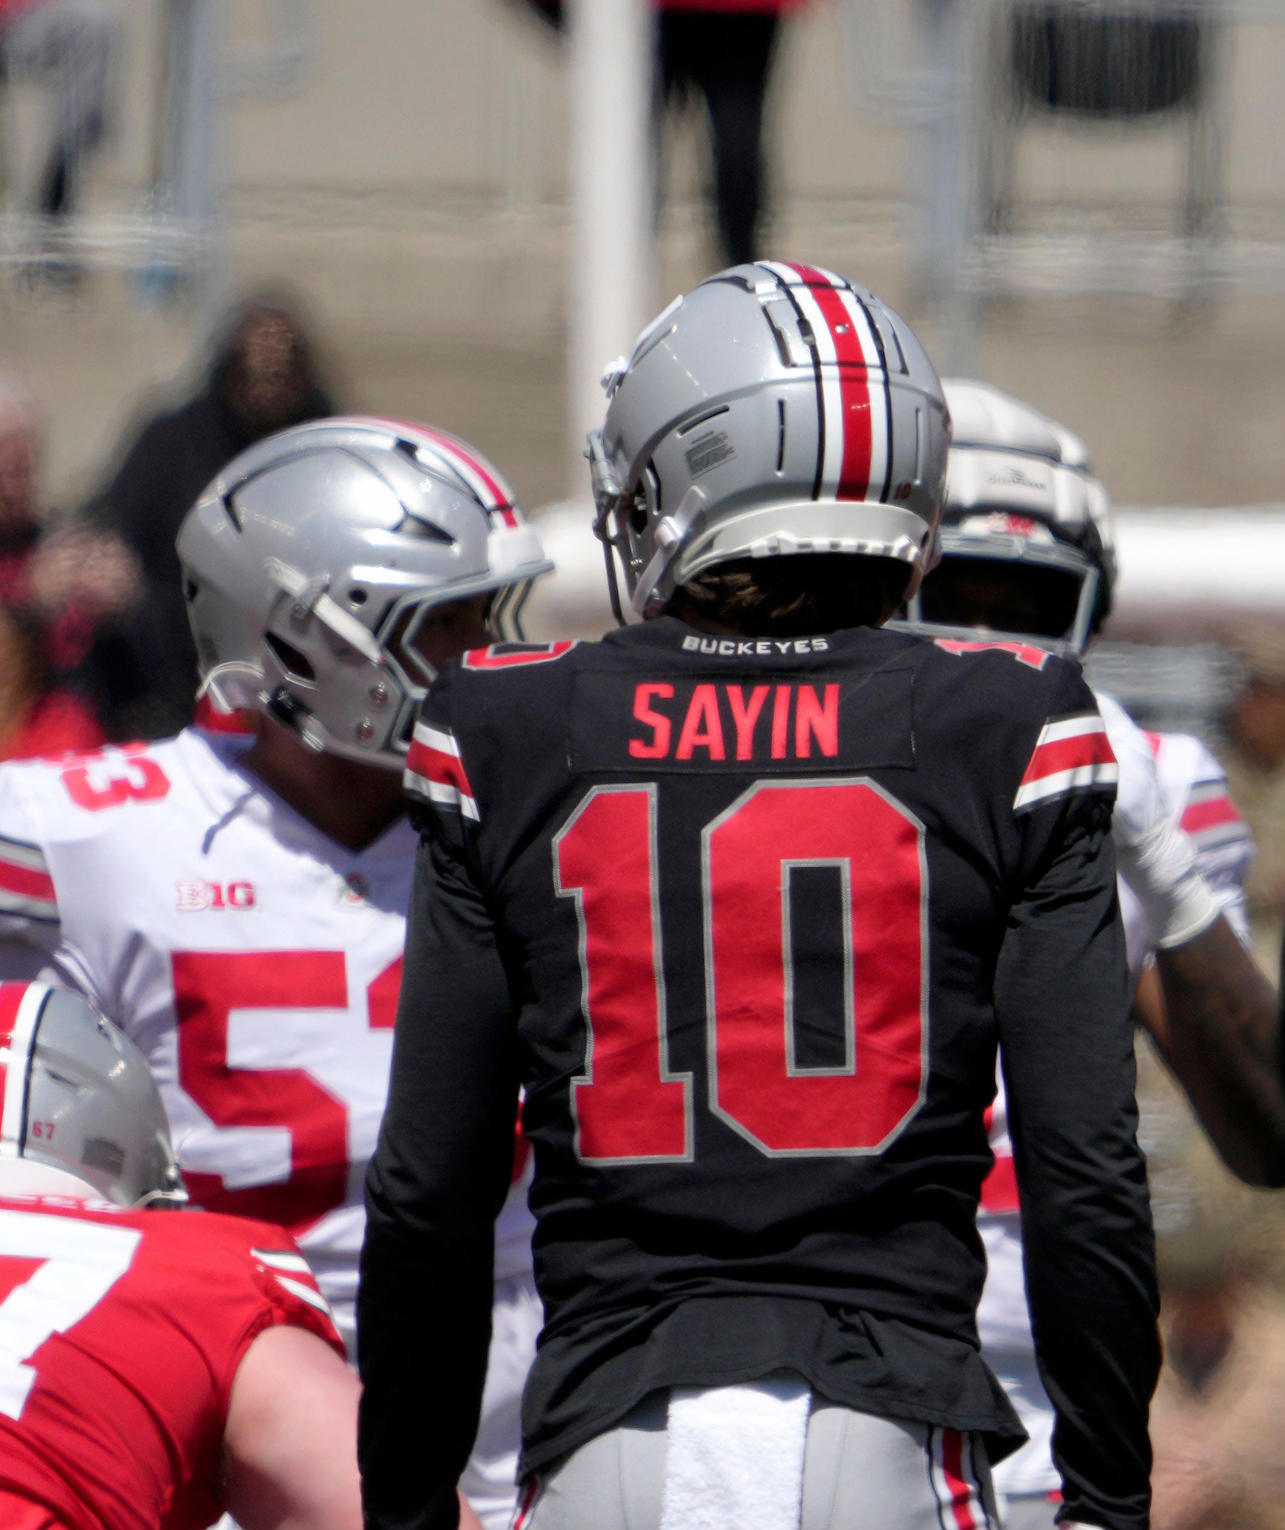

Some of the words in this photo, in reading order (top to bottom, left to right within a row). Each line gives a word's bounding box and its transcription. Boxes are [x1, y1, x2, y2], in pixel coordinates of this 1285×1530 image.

[681, 635, 829, 656] BUCKEYES
[628, 682, 841, 762] SAYIN
[551, 776, 930, 1164] 10
[32, 1119, 56, 1141] 67
